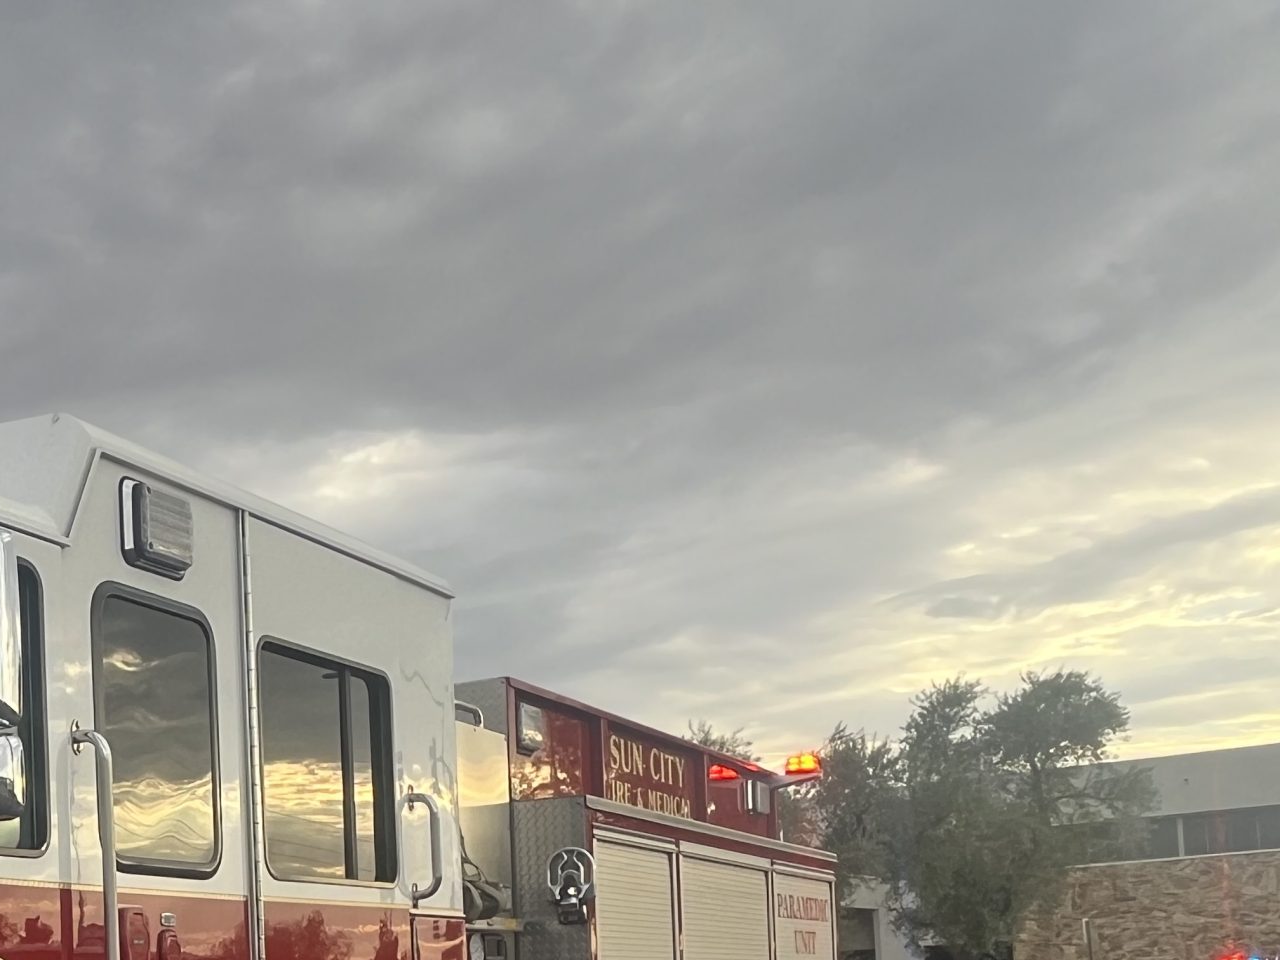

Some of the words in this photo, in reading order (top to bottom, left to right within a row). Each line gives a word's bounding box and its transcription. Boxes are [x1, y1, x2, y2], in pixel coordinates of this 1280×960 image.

[609, 734, 643, 776] SUN
[650, 748, 685, 788] CITY
[776, 893, 829, 922] PARAMEDIC
[794, 930, 817, 955] UNIT
